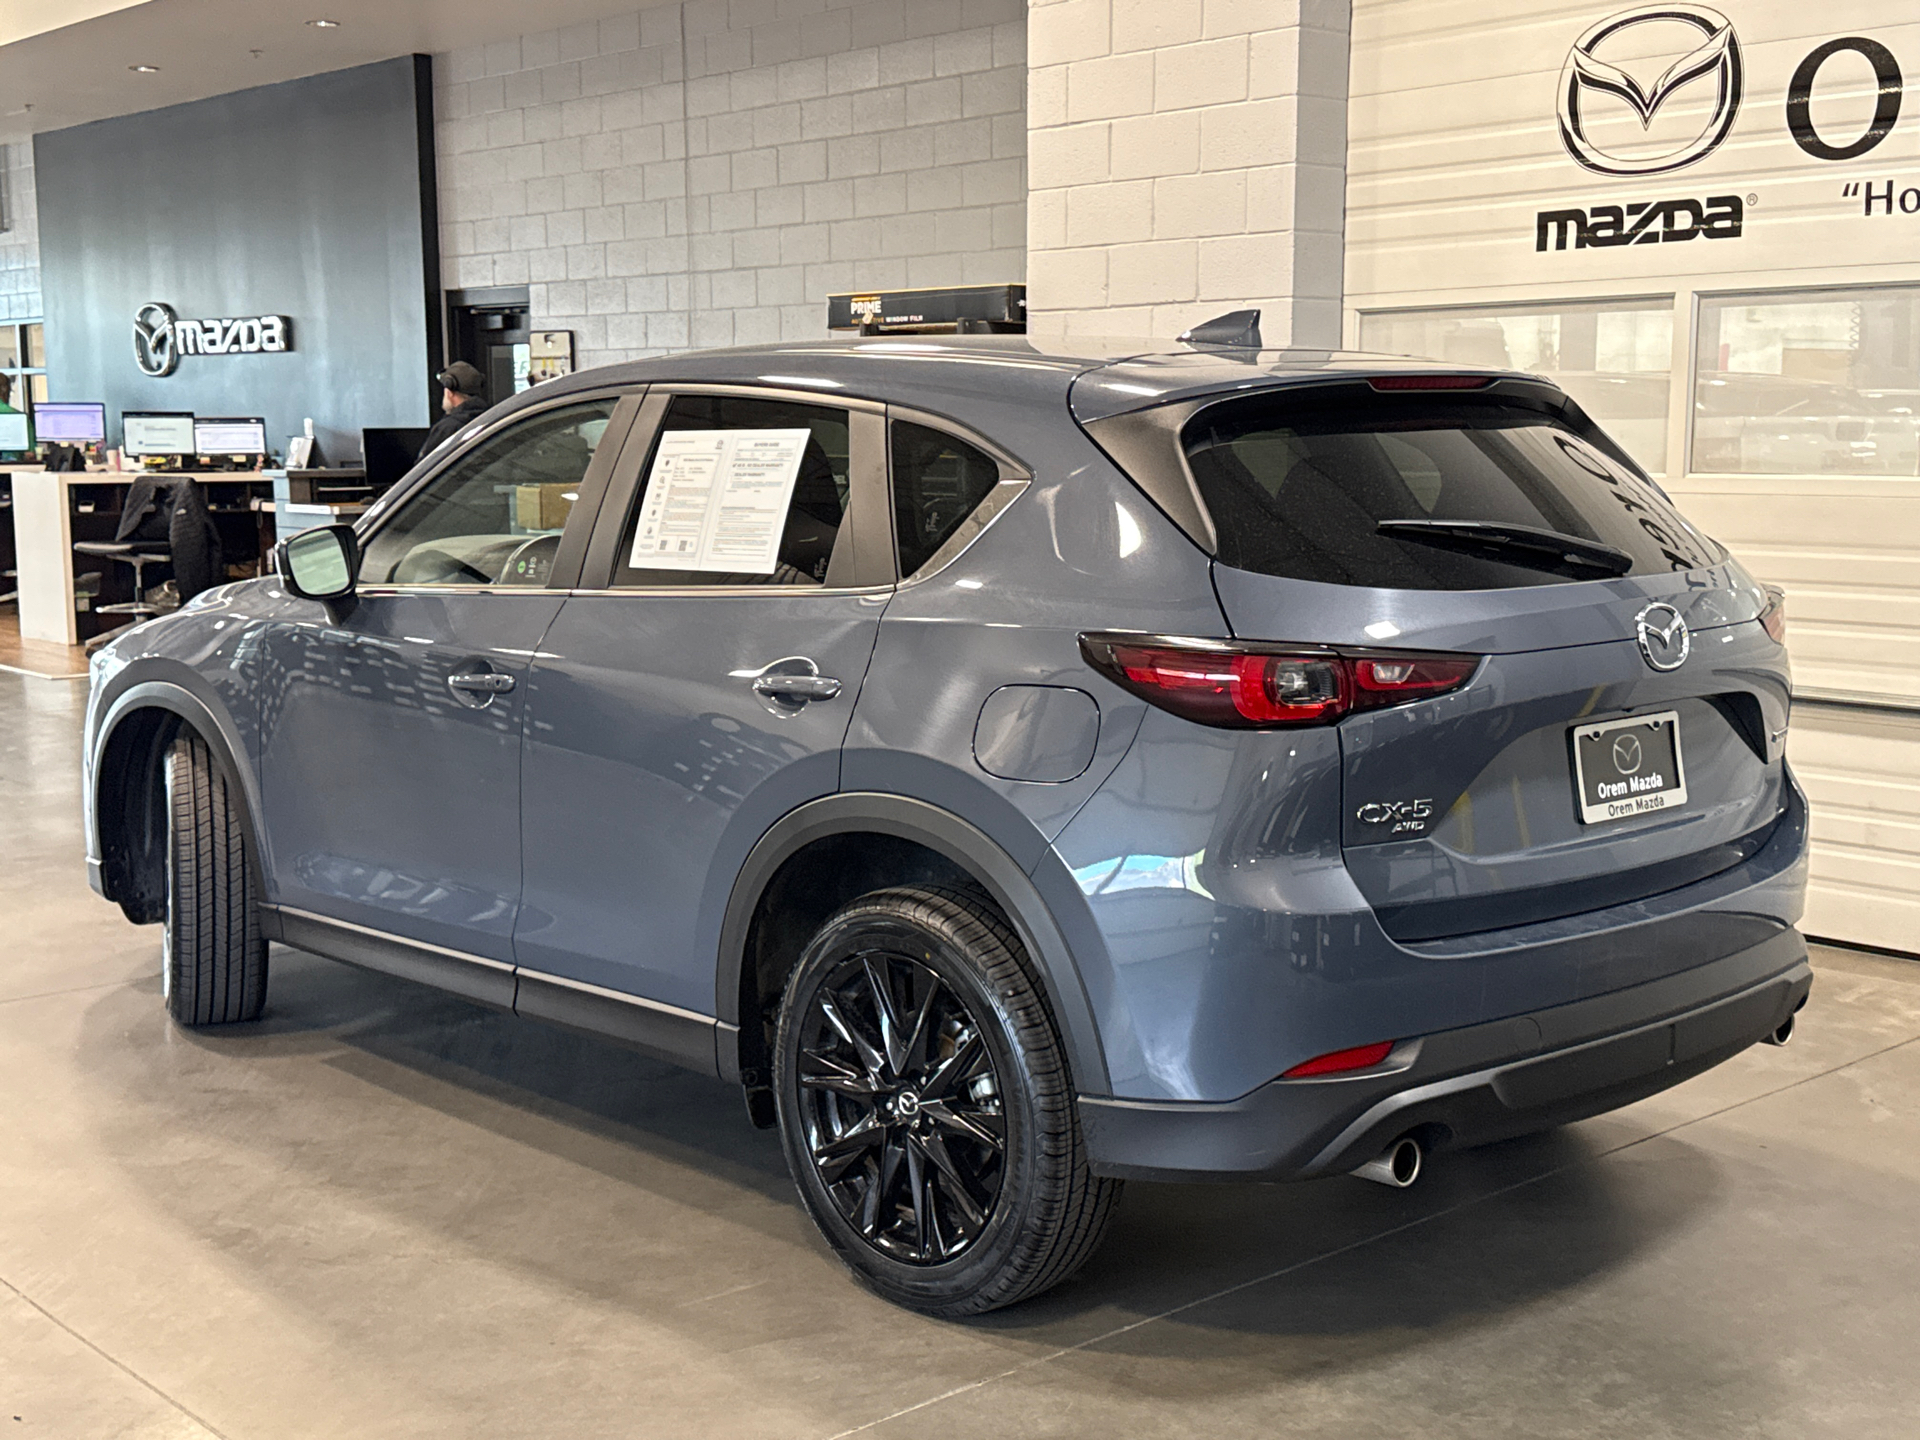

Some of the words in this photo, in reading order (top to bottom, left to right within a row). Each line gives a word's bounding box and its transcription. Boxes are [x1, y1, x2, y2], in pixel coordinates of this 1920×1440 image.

[850, 300, 882, 315] PRIME
[1597, 782, 1628, 799] Orem
[1629, 772, 1664, 792] Mazda
[1356, 798, 1433, 823] CX-5
[1608, 803, 1634, 817] Orem
[1635, 795, 1665, 812] Mazda
[1391, 820, 1425, 833] AWD
